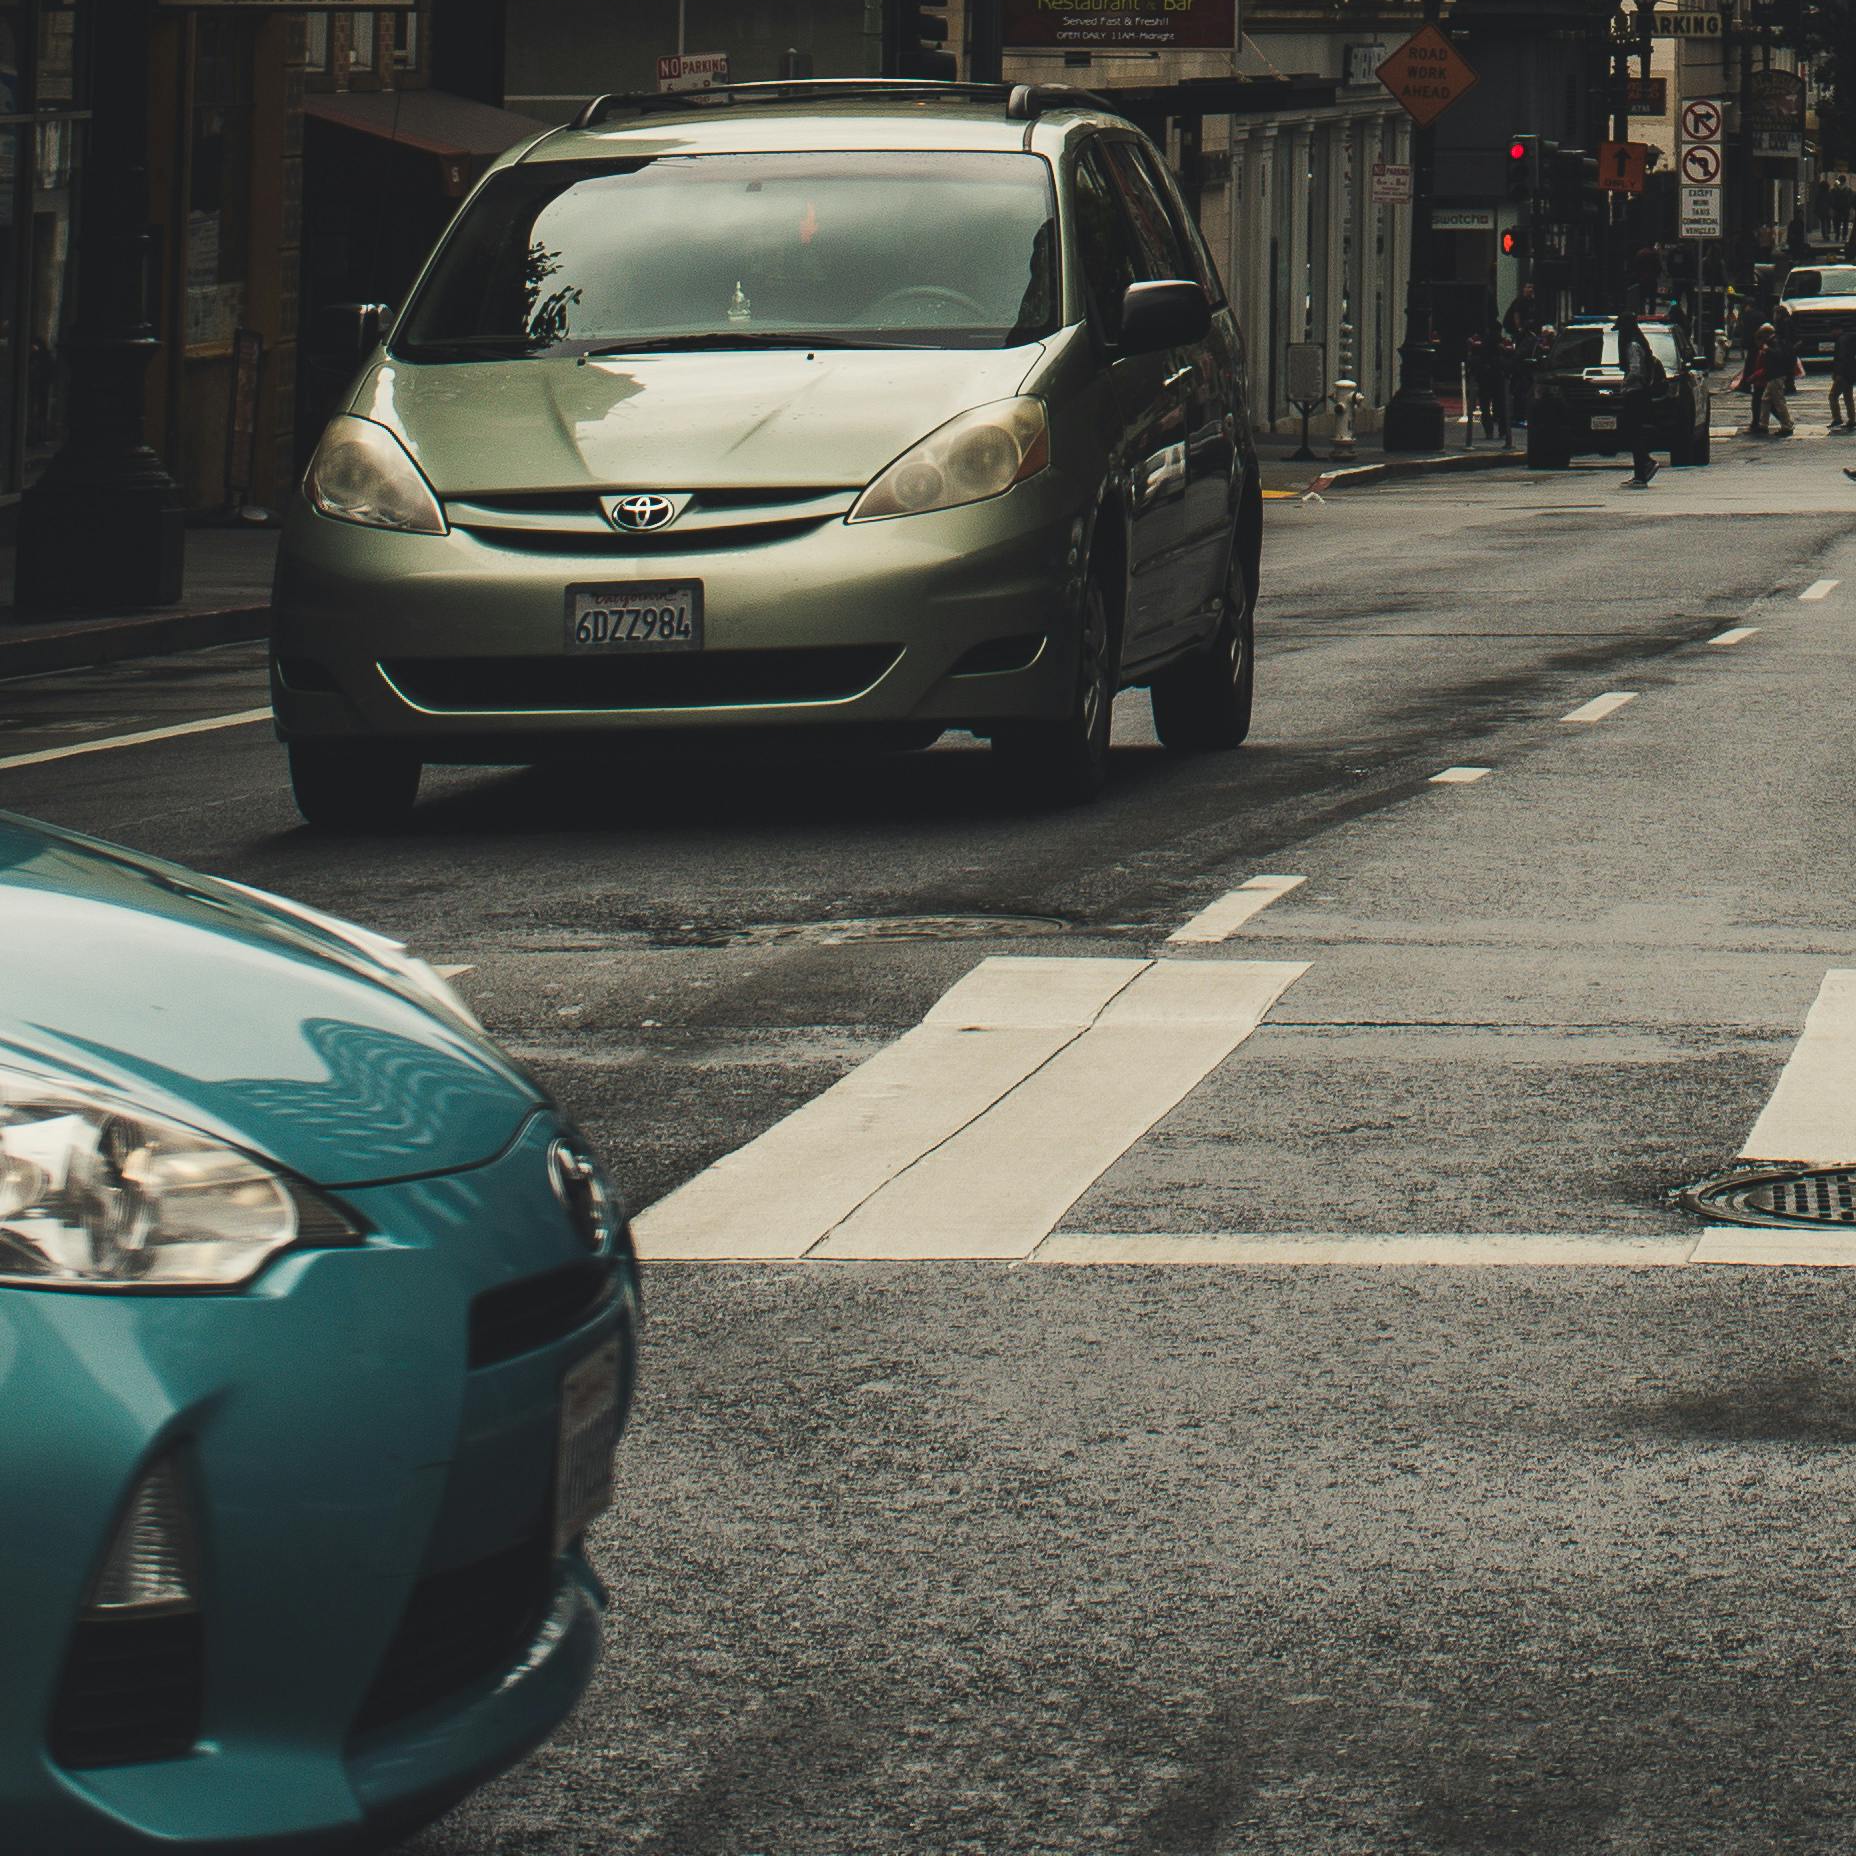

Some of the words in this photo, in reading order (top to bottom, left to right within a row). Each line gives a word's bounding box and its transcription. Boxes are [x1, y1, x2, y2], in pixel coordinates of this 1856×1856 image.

[1063, 16, 1098, 27] Served
[1408, 47, 1448, 61] ROAD
[660, 57, 680, 78] NO
[683, 58, 728, 75] PARKING
[1407, 66, 1448, 80] WORK
[1401, 85, 1451, 99] AHEAD
[1688, 189, 1713, 197] EXCEPT
[575, 606, 691, 644] 6DZZ984
